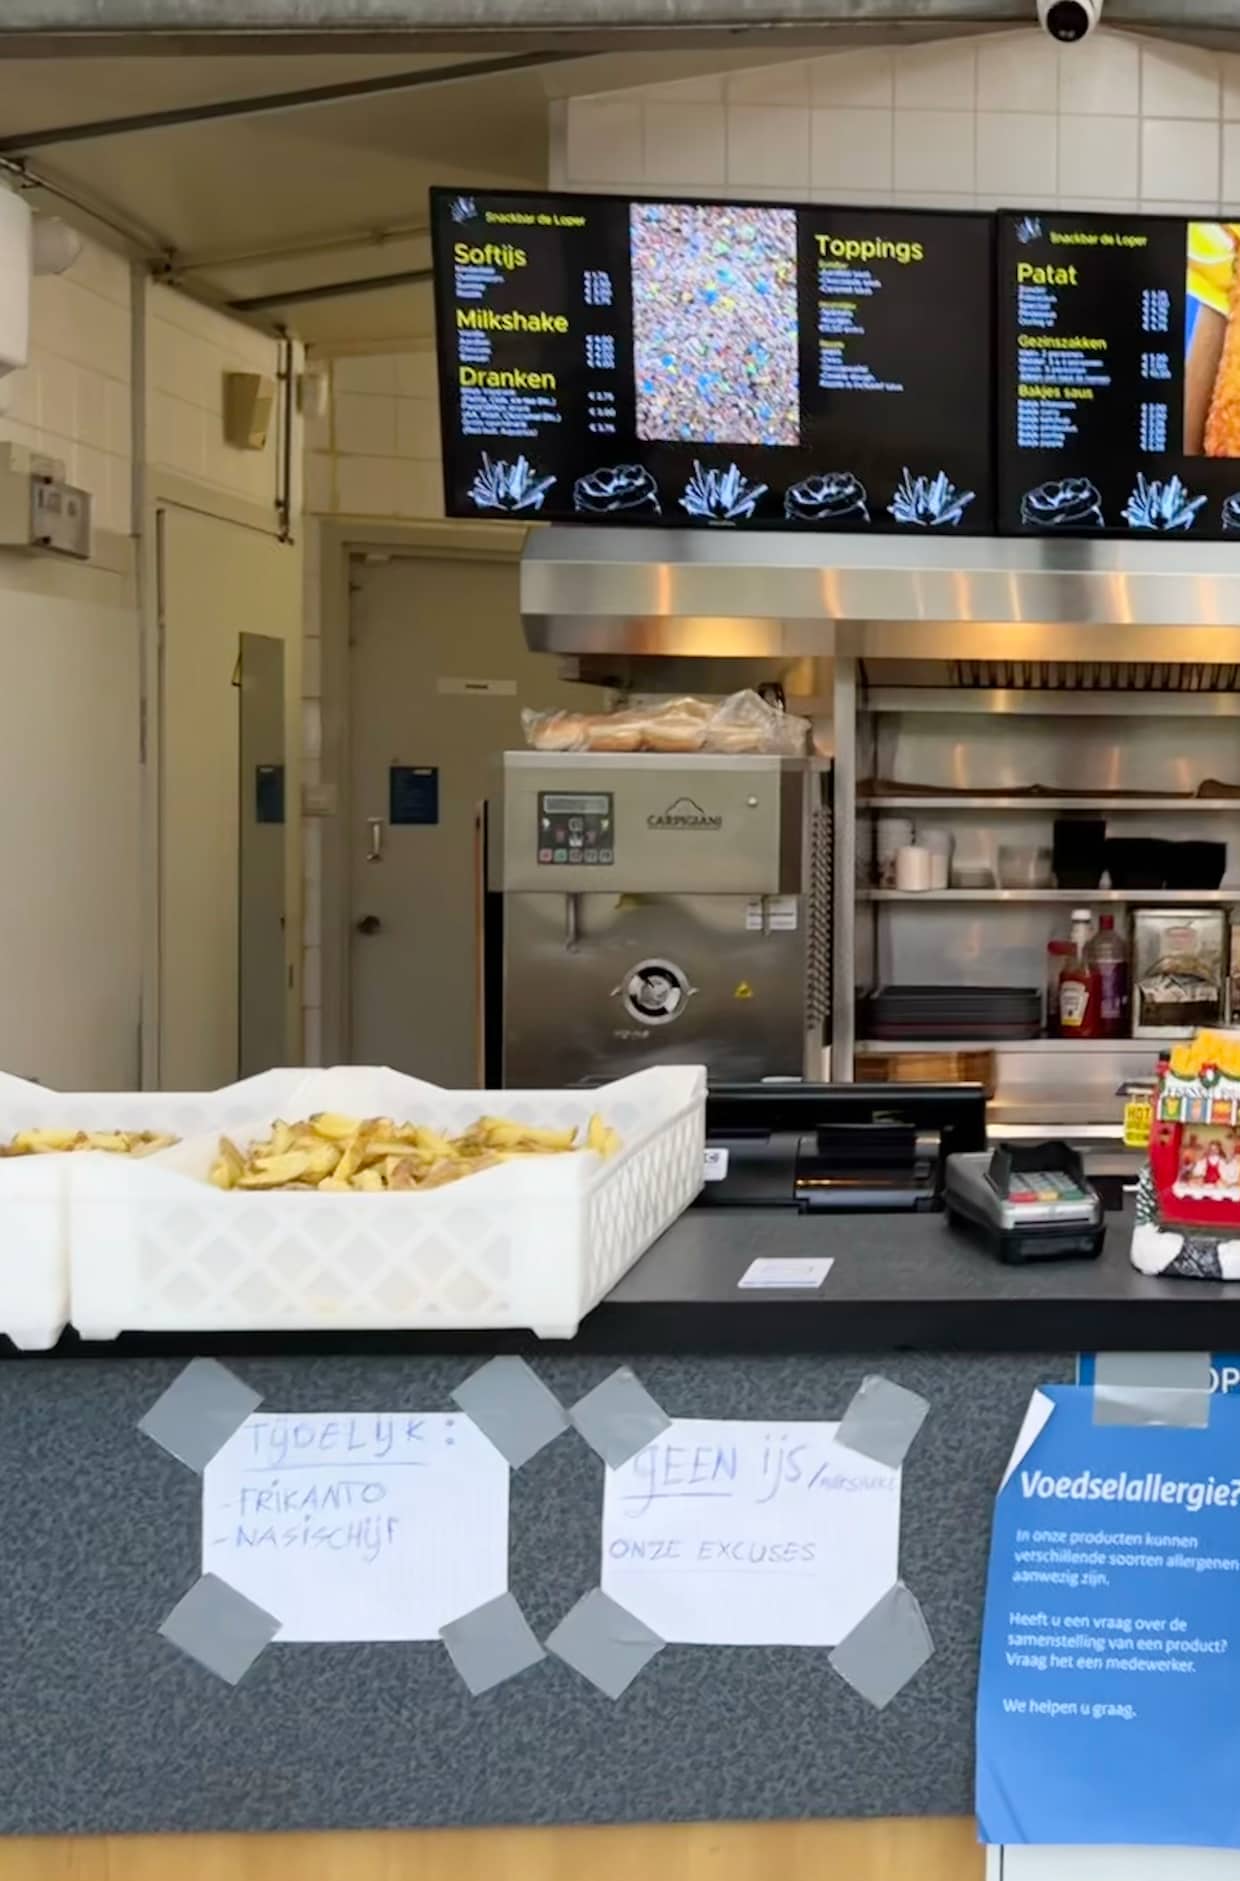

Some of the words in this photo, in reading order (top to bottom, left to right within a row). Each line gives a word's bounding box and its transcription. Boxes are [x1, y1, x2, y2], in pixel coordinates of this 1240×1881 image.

[814, 234, 924, 264] Toppings
[1049, 231, 1099, 245] Snackbar
[454, 242, 528, 270] Softijs
[1017, 262, 1078, 285] Patat
[455, 308, 569, 333] Milkshake
[1017, 334, 1107, 350] Gezinszakken
[459, 366, 556, 390] Dranken
[1018, 384, 1061, 400] Bakjes
[1063, 387, 1094, 399] saus
[1016, 1528, 1030, 1543] In
[1032, 1529, 1067, 1544] onze
[1069, 1529, 1142, 1547] producten
[1145, 1532, 1198, 1549] kunnen
[697, 1539, 816, 1564] EXCUSES
[1014, 1548, 1106, 1566] verschillende
[1109, 1554, 1163, 1568] soorten
[1166, 1554, 1240, 1573] allergenen
[1012, 1569, 1079, 1588] aanwezig
[1081, 1570, 1110, 1588] zijn.
[1009, 1611, 1049, 1628] Heeft
[1051, 1616, 1062, 1627] u
[1064, 1615, 1090, 1628] een
[1093, 1617, 1132, 1634] vraag
[1134, 1618, 1166, 1631] over
[1169, 1617, 1188, 1632] de
[1007, 1632, 1106, 1652] samenstelling
[1108, 1638, 1134, 1651] van
[1136, 1639, 1163, 1652] een
[1165, 1639, 1229, 1655] product?
[1005, 1652, 1048, 1670] Vraag
[1050, 1652, 1074, 1669] het
[1076, 1656, 1102, 1670] een
[1105, 1656, 1197, 1673] medewerker.
[1002, 1698, 1026, 1714] We
[1029, 1698, 1077, 1718] helpen
[1080, 1704, 1090, 1716] u
[1092, 1703, 1137, 1720] graag.
